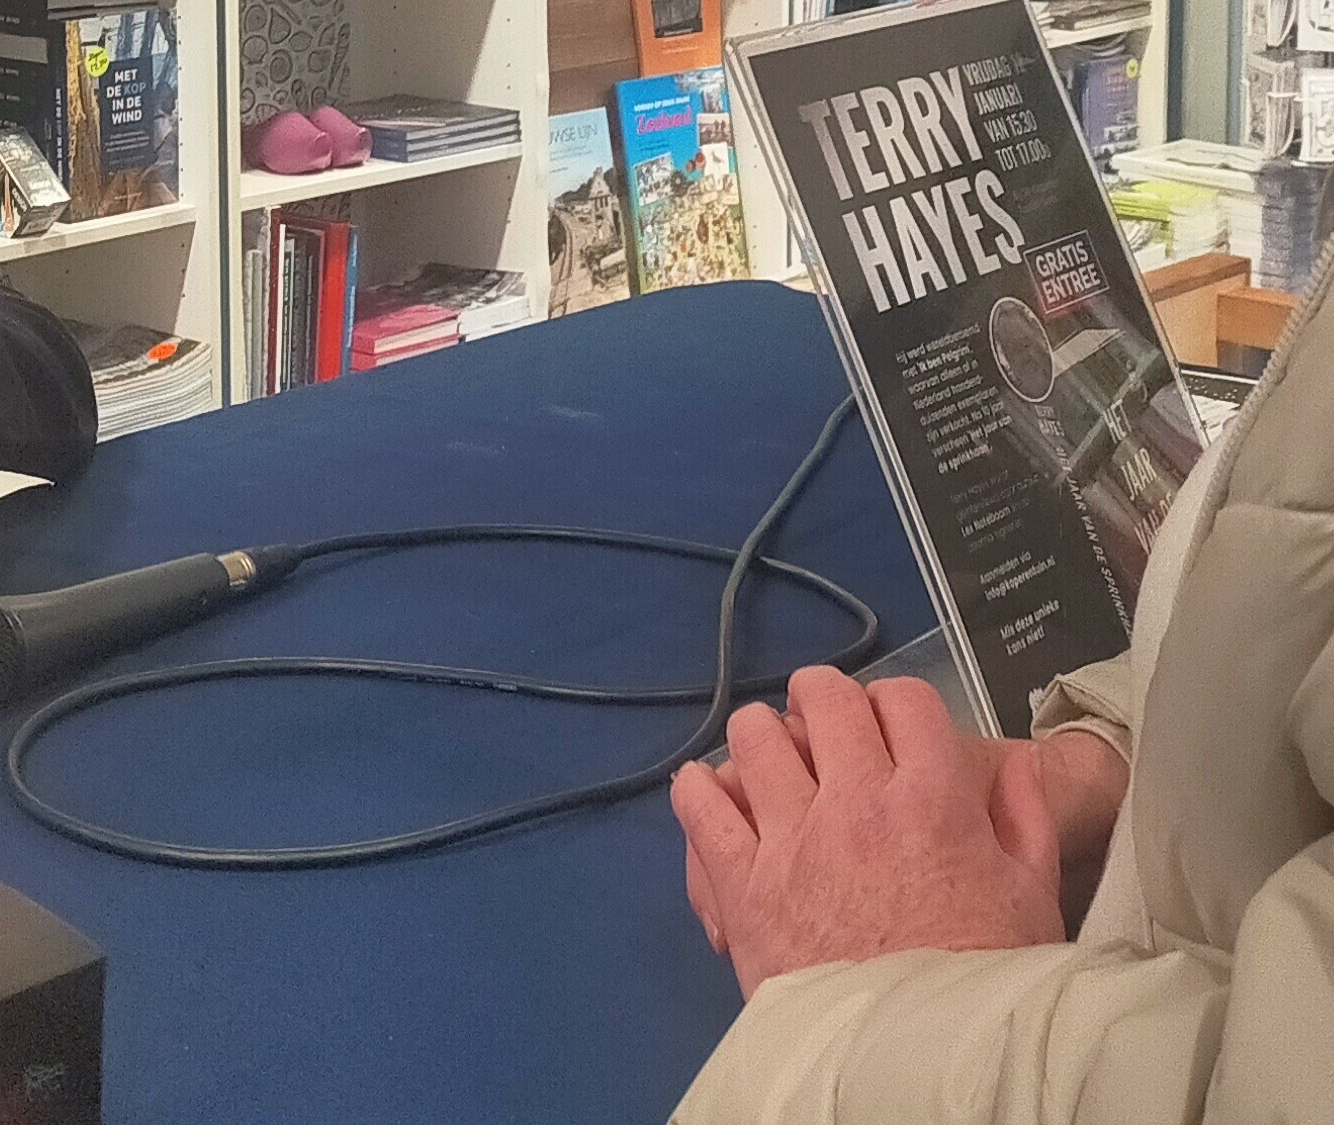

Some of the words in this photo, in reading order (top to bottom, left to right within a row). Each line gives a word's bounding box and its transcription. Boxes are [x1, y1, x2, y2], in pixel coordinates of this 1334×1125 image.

[114, 69, 138, 83] MET
[962, 55, 1012, 87] VRIJDAG
[106, 86, 122, 99] DE
[123, 81, 147, 96] KOP
[112, 98, 125, 112] IN
[125, 96, 142, 110] DE
[973, 82, 1024, 116] JANUARI
[111, 109, 143, 125] WIND
[798, 65, 983, 201] TERRY
[983, 116, 1010, 143] VAN
[1005, 109, 1038, 137] 15.30
[994, 145, 1019, 172] TOT
[841, 168, 1025, 314] HAYES
[1034, 240, 1090, 278] GRATIS
[1041, 266, 1102, 305] ENTREE
[937, 461, 949, 475] de
[1120, 447, 1158, 501] JAAR
[1020, 549, 1033, 563] via
[1091, 545, 1108, 566] DE
[1015, 612, 1034, 634] deze
[1033, 598, 1061, 623] unieke
